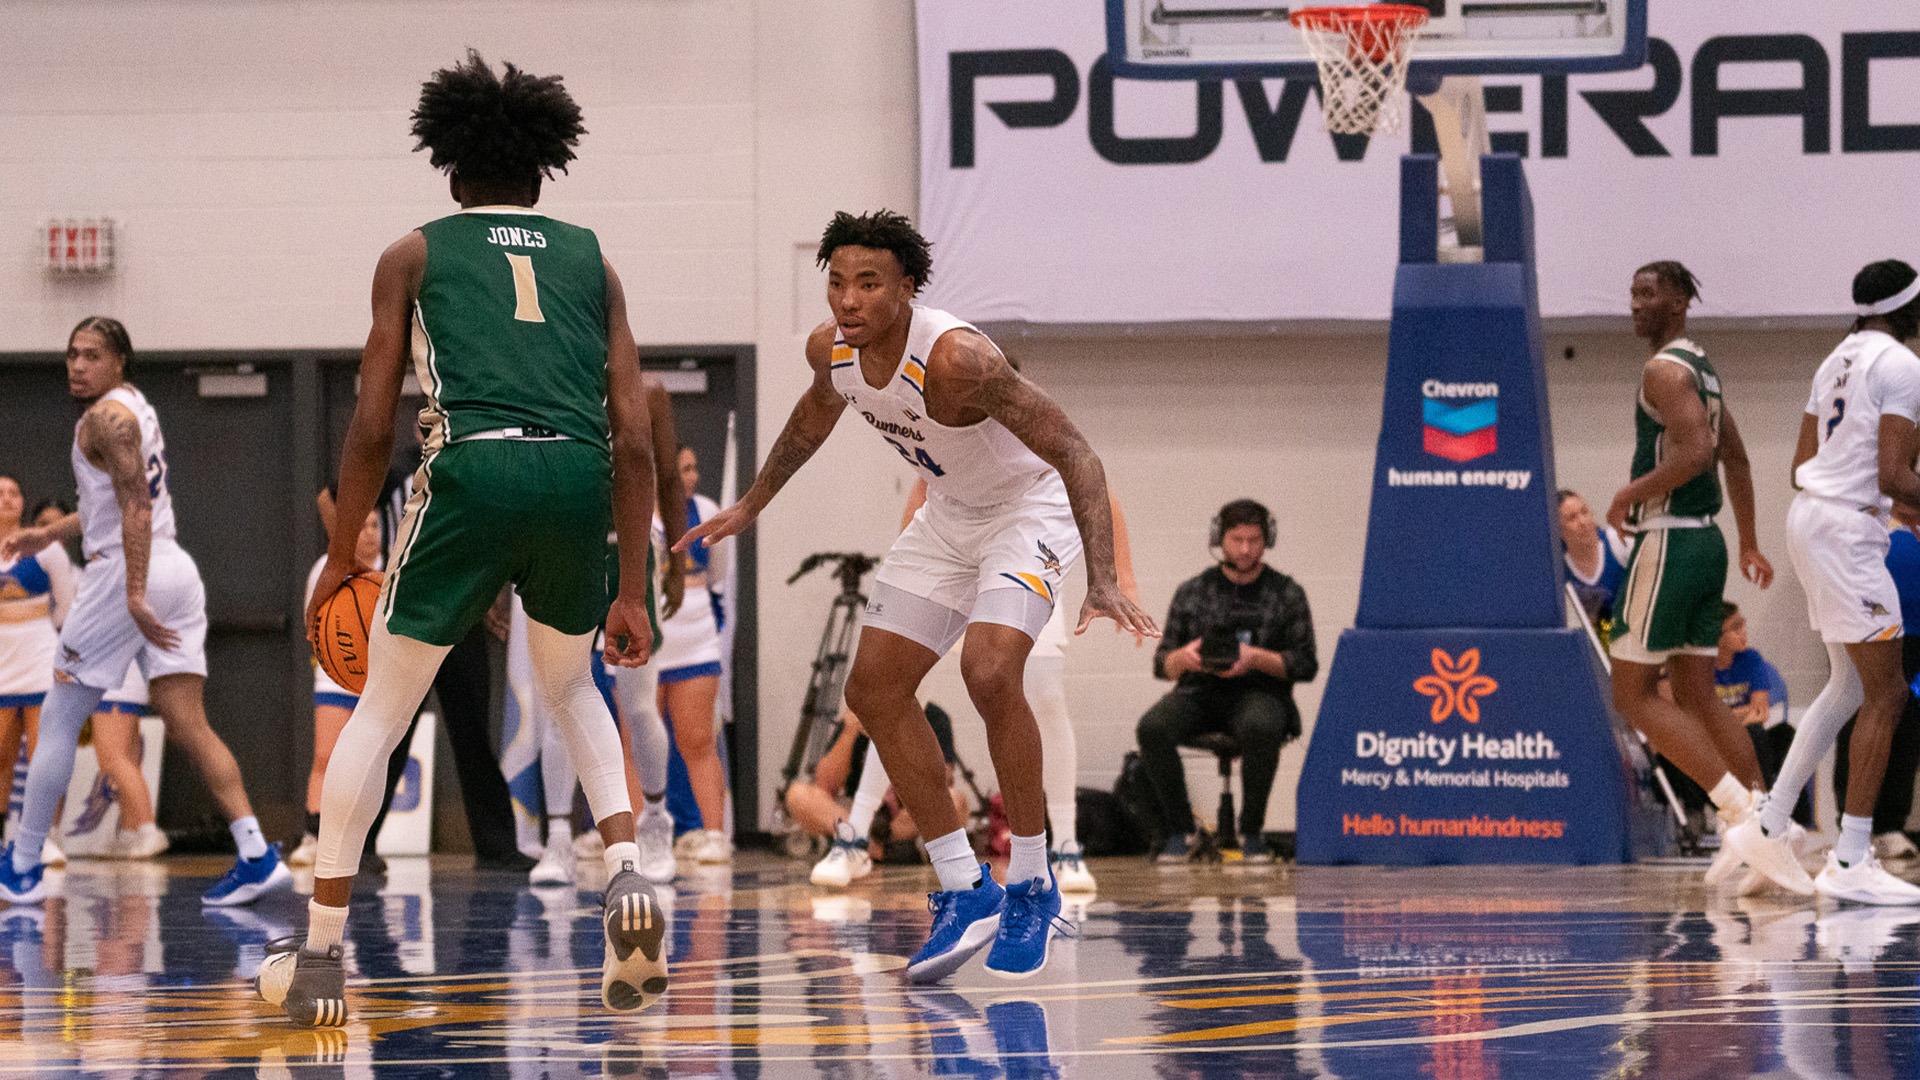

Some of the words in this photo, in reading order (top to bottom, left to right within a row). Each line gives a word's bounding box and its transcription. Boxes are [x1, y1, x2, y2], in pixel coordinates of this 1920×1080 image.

[48, 227, 98, 258] EXIT
[487, 227, 547, 248] JONES
[504, 252, 546, 323] 1
[1422, 379, 1499, 398] Chevron
[882, 435, 946, 477] 24
[1388, 468, 1459, 487] human
[1461, 471, 1532, 490] energy
[1356, 731, 1457, 766] Dignity
[1341, 769, 1393, 790] Mercy
[1395, 769, 1410, 787] &
[1414, 769, 1490, 788] Memorial
[1494, 770, 1570, 791] Hospitals
[1343, 814, 1396, 836] Hello
[1400, 814, 1564, 838] humankindness
